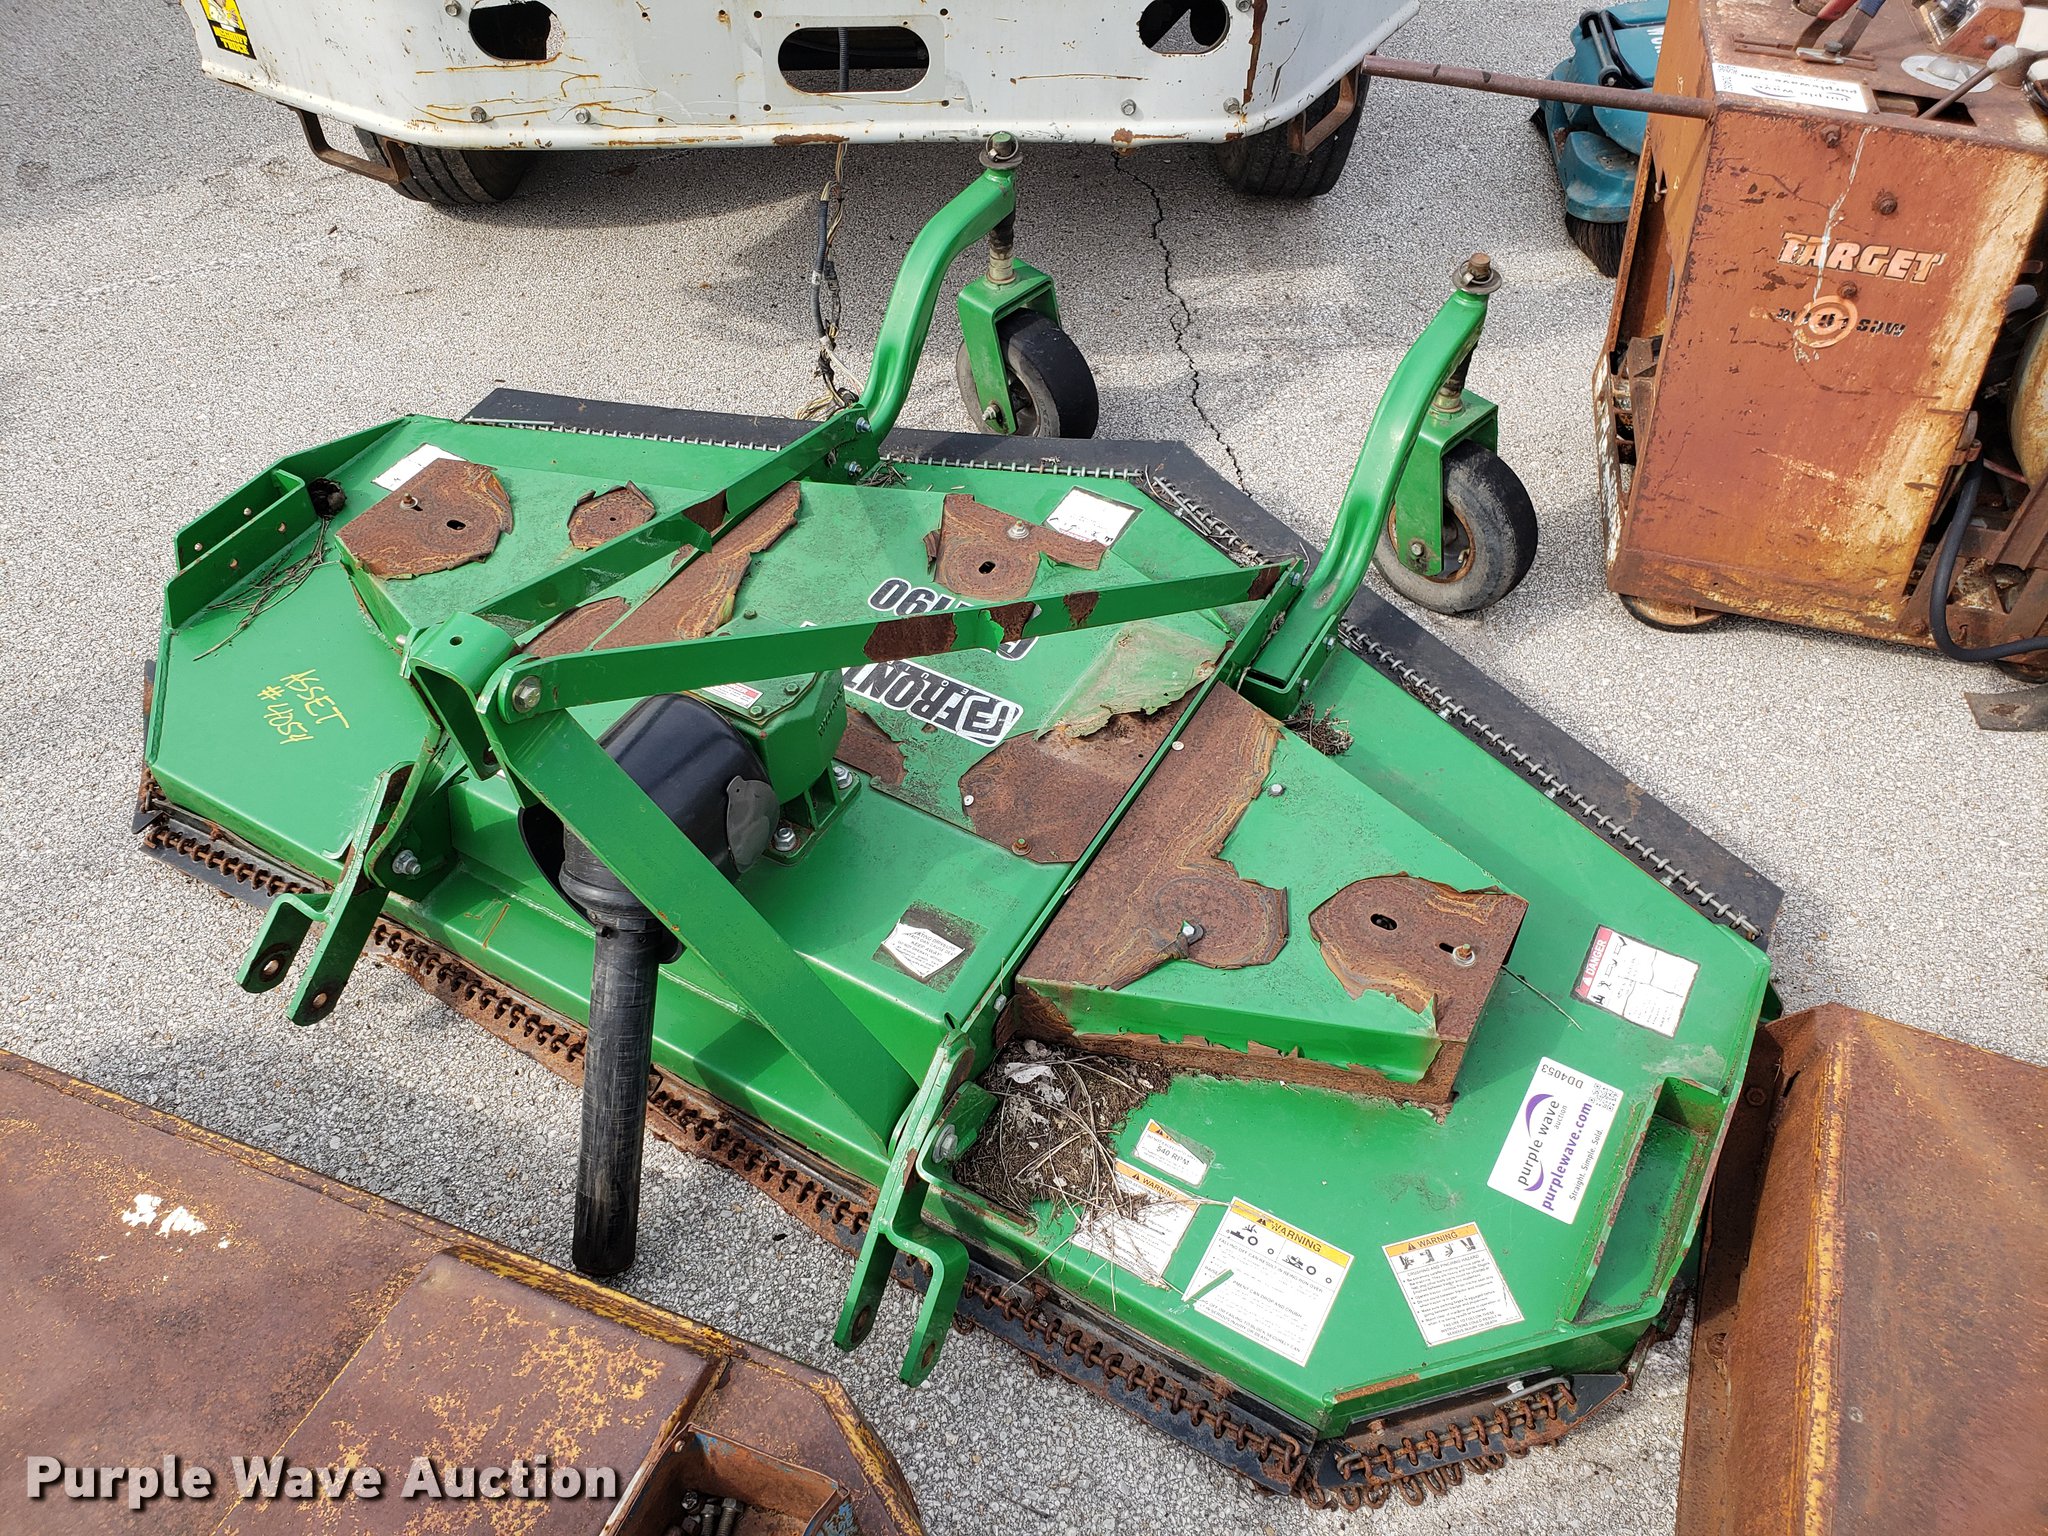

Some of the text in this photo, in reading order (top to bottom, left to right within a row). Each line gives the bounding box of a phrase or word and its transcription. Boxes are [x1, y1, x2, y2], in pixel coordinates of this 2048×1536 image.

[1777, 232, 1949, 286] TARGET
[257, 686, 314, 744] #4054
[279, 669, 350, 728] ASSET
[1584, 938, 1607, 976] DANGER
[1540, 1063, 1584, 1089] DD4053
[1553, 1104, 1568, 1129] auction
[1156, 1144, 1170, 1156] 540
[1517, 1099, 1560, 1186] purple wave
[1541, 1102, 1593, 1211] purplewave.com
[1140, 1176, 1178, 1200] WARNING
[1269, 1221, 1322, 1253] WARNING
[1416, 1231, 1458, 1247] WARNING
